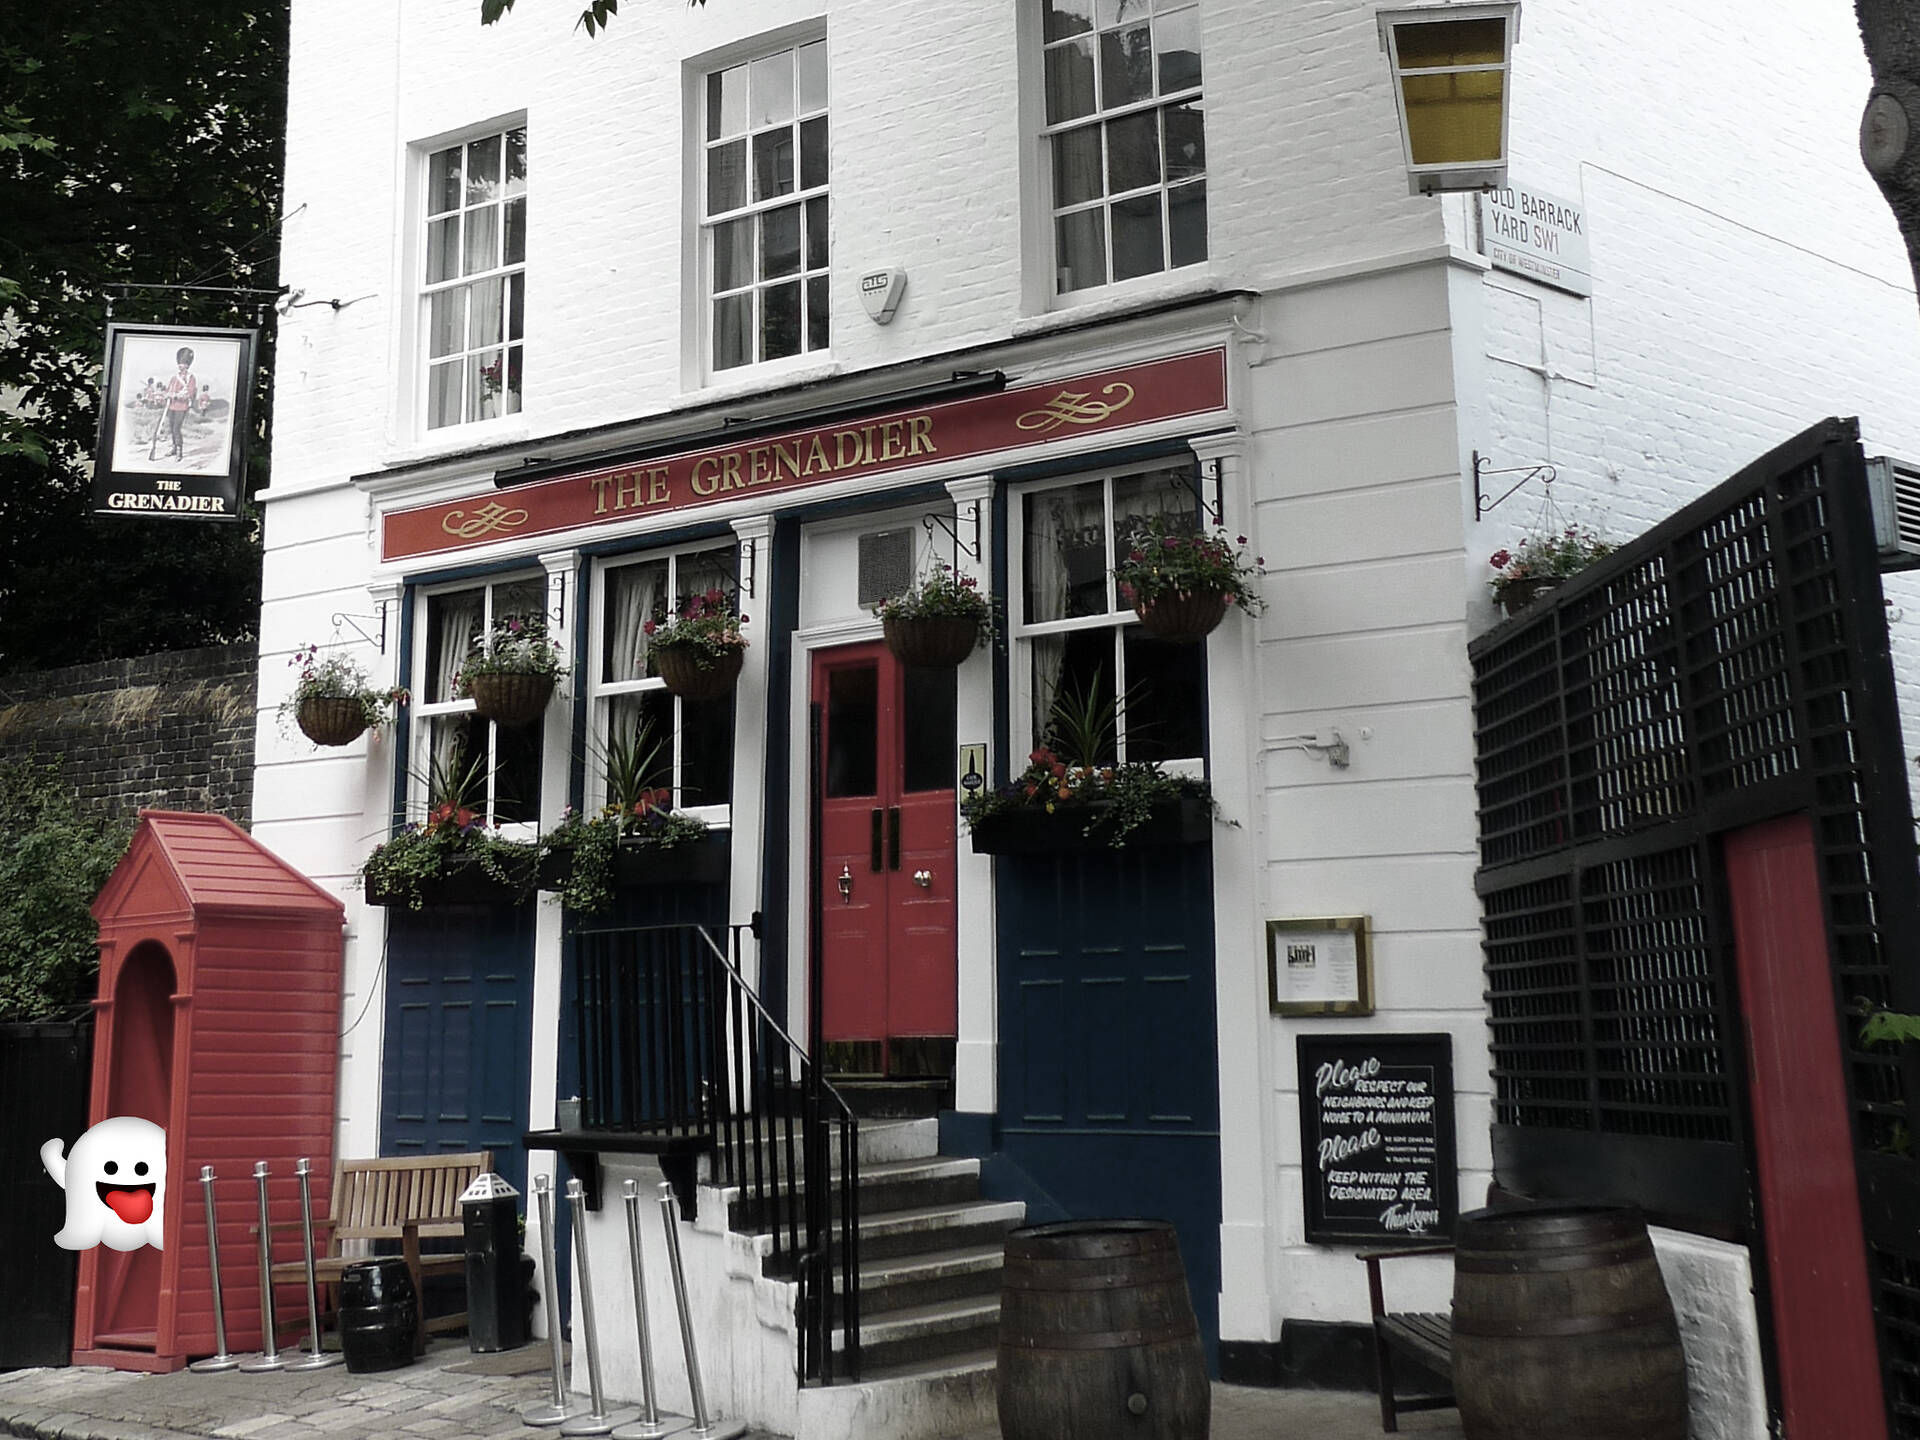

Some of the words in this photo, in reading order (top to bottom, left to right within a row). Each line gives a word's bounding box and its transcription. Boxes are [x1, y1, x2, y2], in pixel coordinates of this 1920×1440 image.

[1490, 187, 1515, 210] OLD
[1520, 192, 1583, 236] BARRACK
[1491, 209, 1529, 243] YARD
[1534, 225, 1560, 255] SW1
[590, 465, 671, 514] THE
[691, 415, 937, 497] GRENADIER
[156, 480, 182, 491] THE
[107, 492, 225, 513] GRENADIER
[1315, 1057, 1381, 1098] Please
[1354, 1080, 1406, 1093] RESPECT
[1406, 1081, 1428, 1093] OUR
[1322, 1096, 1387, 1109] NEIGHBOURS
[1386, 1097, 1409, 1109] AND
[1408, 1096, 1435, 1109] KEEP
[1322, 1112, 1351, 1124] NOISE
[1351, 1112, 1365, 1124] TO
[1366, 1111, 1375, 1123] A
[1318, 1127, 1381, 1171] Please
[1327, 1170, 1358, 1184] KEEP
[1359, 1171, 1402, 1185] WITHIN
[1404, 1171, 1429, 1185] THE
[1329, 1185, 1398, 1201] DESIGNATED
